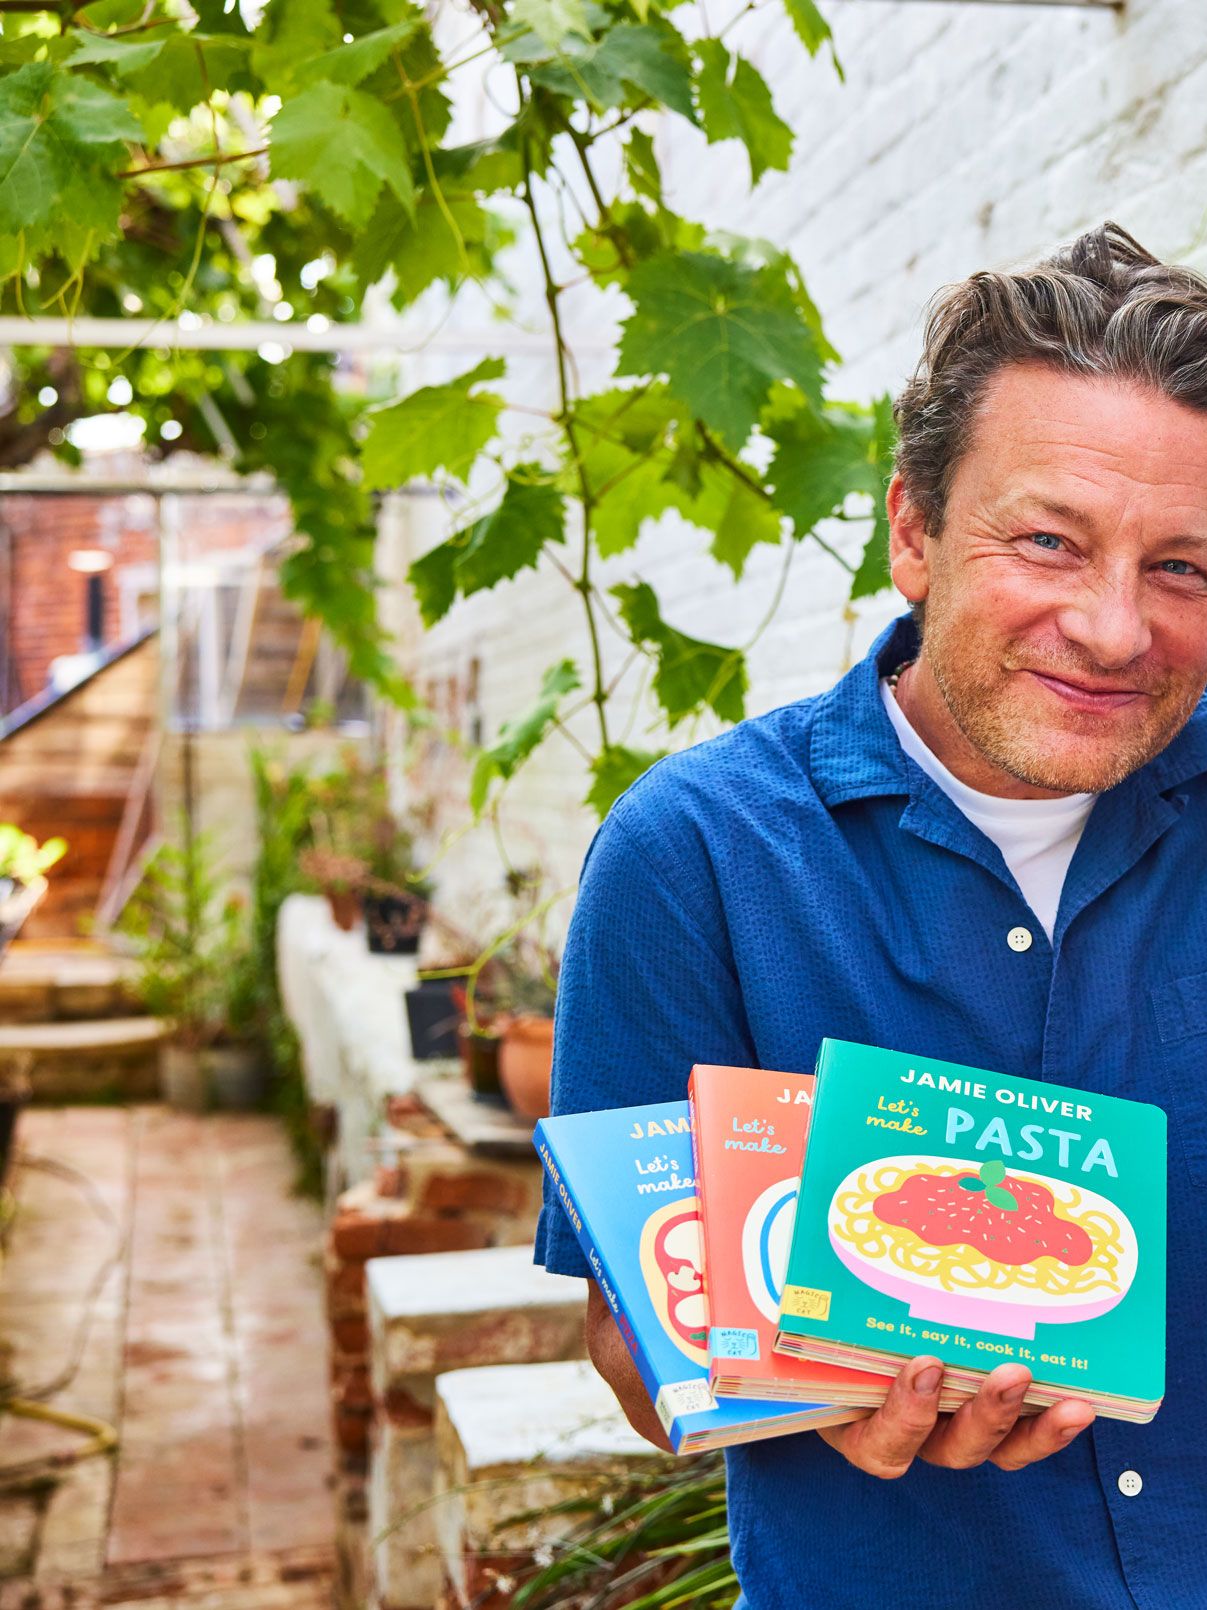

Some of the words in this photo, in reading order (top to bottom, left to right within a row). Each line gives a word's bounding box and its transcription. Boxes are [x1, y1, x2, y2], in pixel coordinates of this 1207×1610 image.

[877, 1096, 919, 1117] Let's
[900, 1069, 987, 1100] JAMIE
[995, 1089, 1093, 1122] OLIVER
[630, 1117, 691, 1139] JAM
[732, 1117, 775, 1136] Let's
[866, 1114, 928, 1136] make
[724, 1137, 787, 1154] make
[945, 1107, 1119, 1178] PASTA
[635, 1155, 679, 1175] Let's
[540, 1144, 560, 1185] JAMIE
[559, 1184, 582, 1233] OLIVER
[637, 1173, 696, 1194] make
[865, 1317, 894, 1332] See
[899, 1323, 916, 1338] it,
[921, 1329, 949, 1344] say
[954, 1334, 971, 1349] it,
[976, 1340, 1013, 1356] cook
[1018, 1347, 1036, 1362] it,
[1040, 1353, 1067, 1367] eat
[1071, 1356, 1088, 1370] it!
